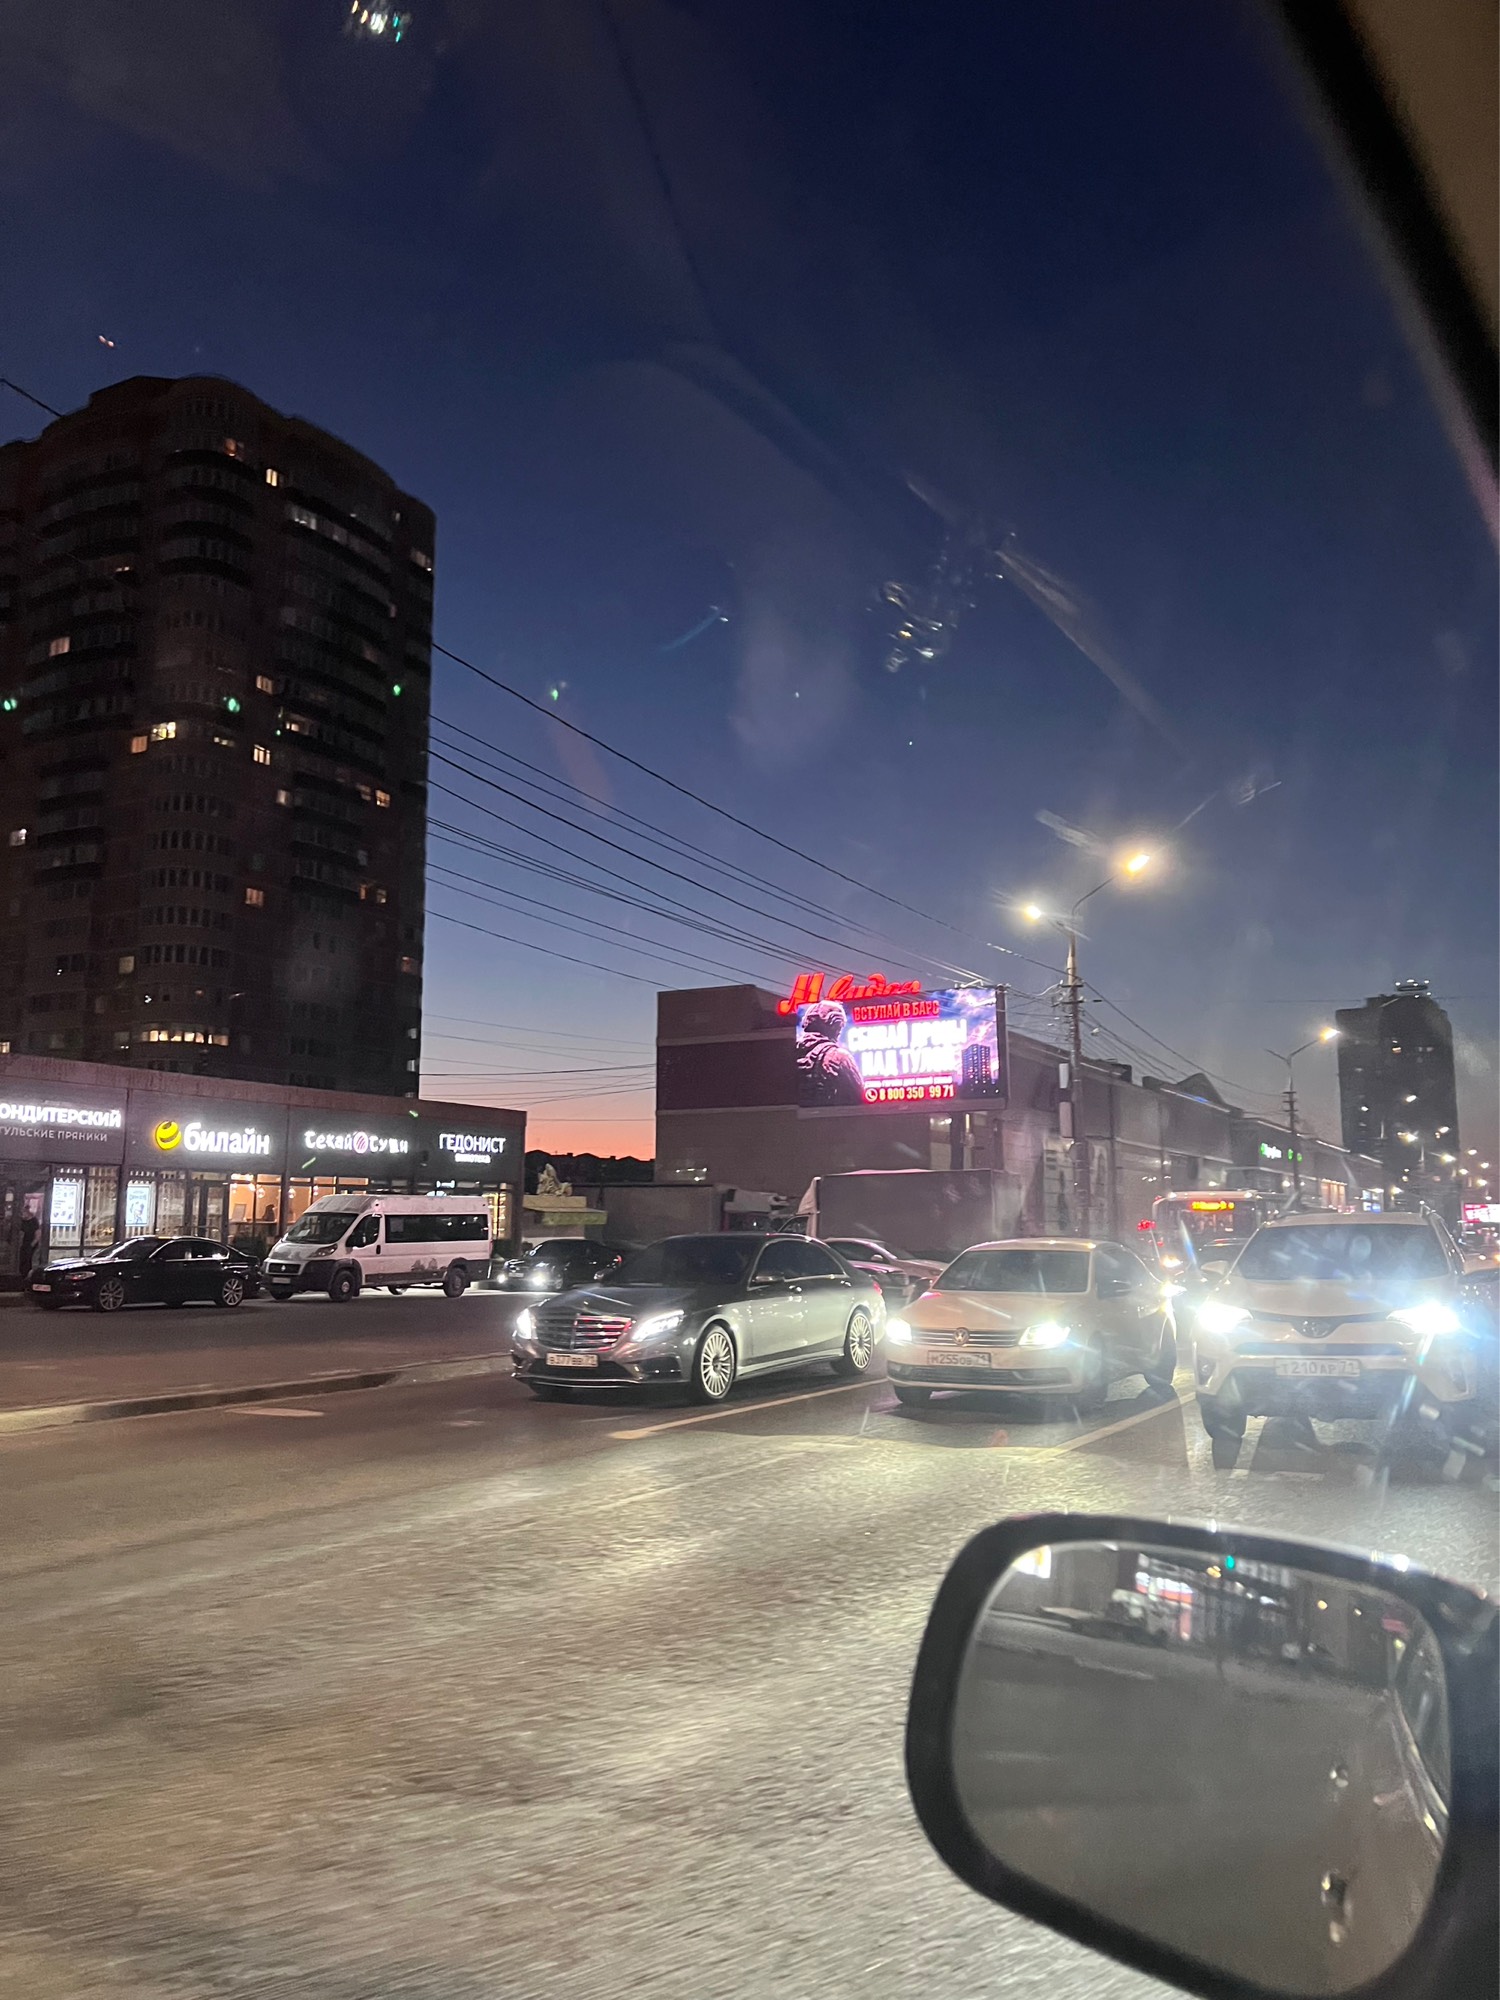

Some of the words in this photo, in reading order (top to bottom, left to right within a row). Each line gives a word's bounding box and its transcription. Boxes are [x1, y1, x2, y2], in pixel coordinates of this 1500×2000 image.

[853, 1002, 901, 1021] ВСТУПАЙ
[902, 1002, 911, 1017] В
[912, 1000, 940, 1017] БАРС
[879, 1088, 886, 1101] 8
[887, 1087, 905, 1101] 800
[906, 1085, 924, 1100] 350
[928, 1085, 941, 1099] 99
[942, 1084, 955, 1098] 71
[57, 1130, 108, 1142] ПРЯНИКИ
[183, 1122, 270, 1155] билайн
[439, 1133, 506, 1154] ГЕДОНИСТ
